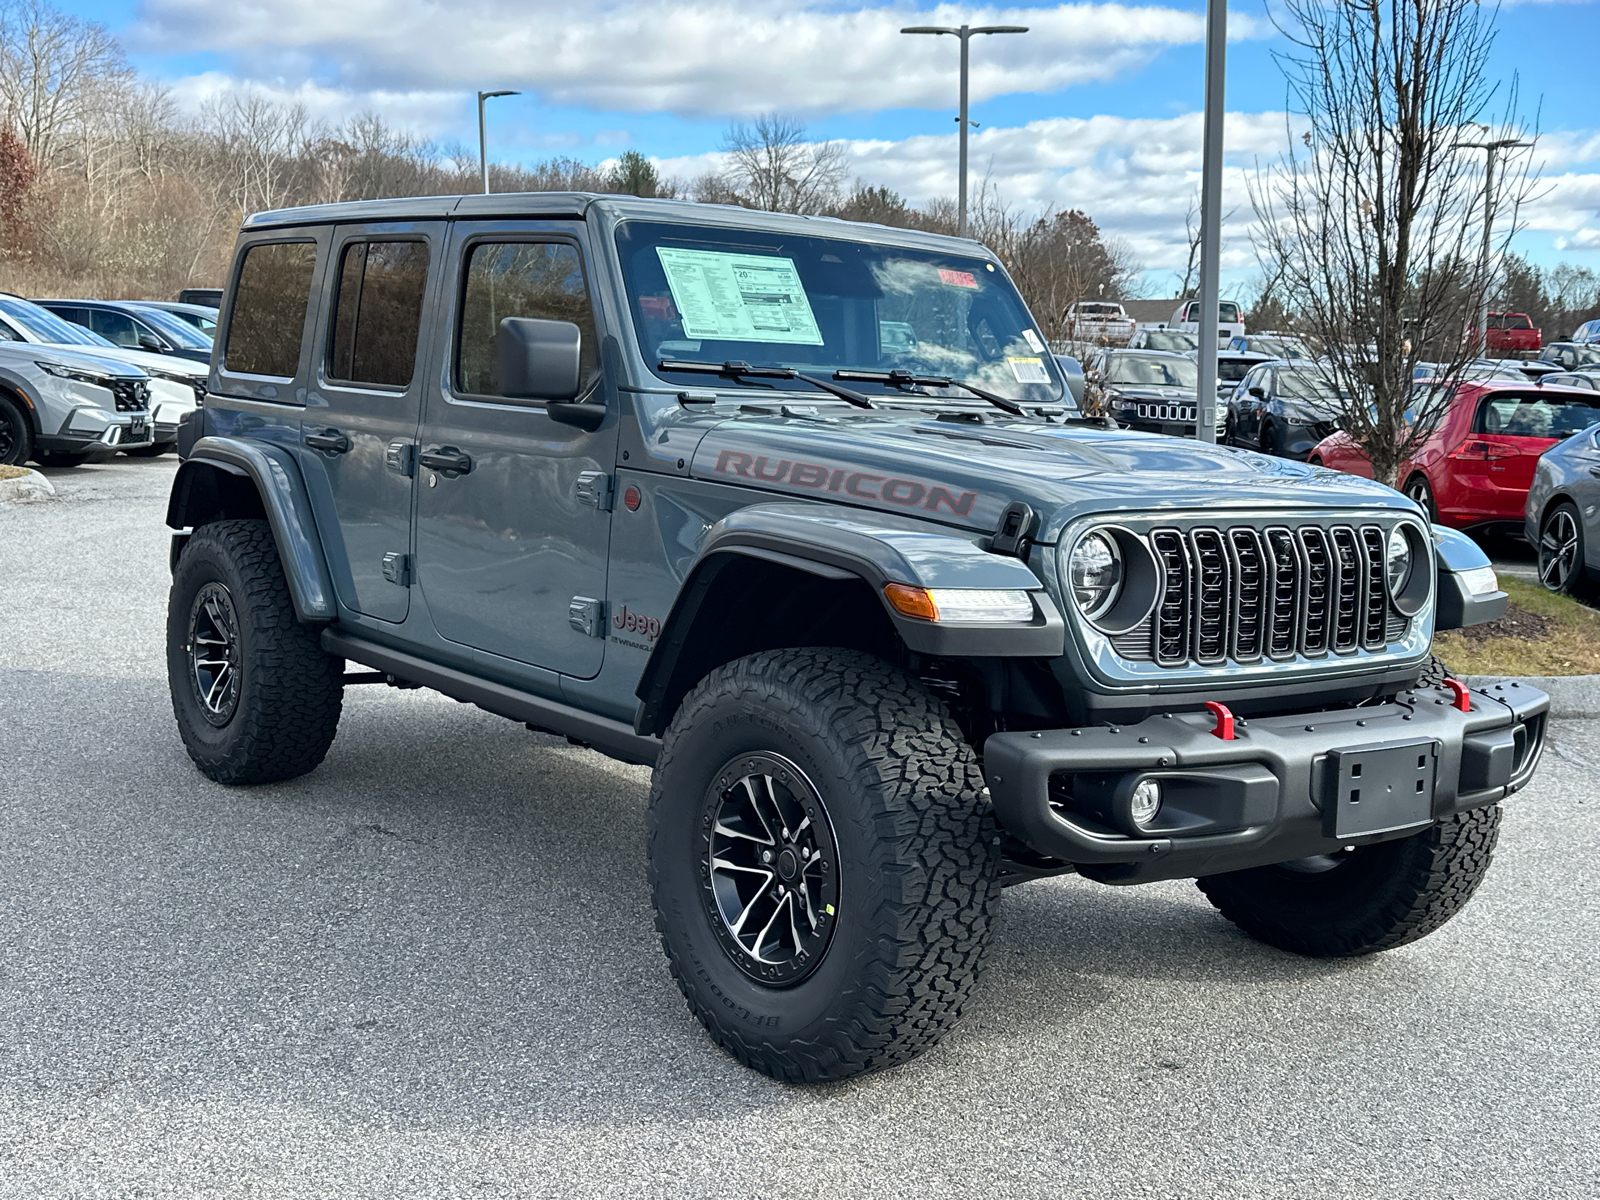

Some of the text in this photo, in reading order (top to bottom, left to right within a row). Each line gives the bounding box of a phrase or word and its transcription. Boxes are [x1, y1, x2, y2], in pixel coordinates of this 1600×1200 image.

[714, 449, 978, 517] RUBICON
[613, 604, 660, 642] Jeep
[619, 638, 655, 652] WRANGL
